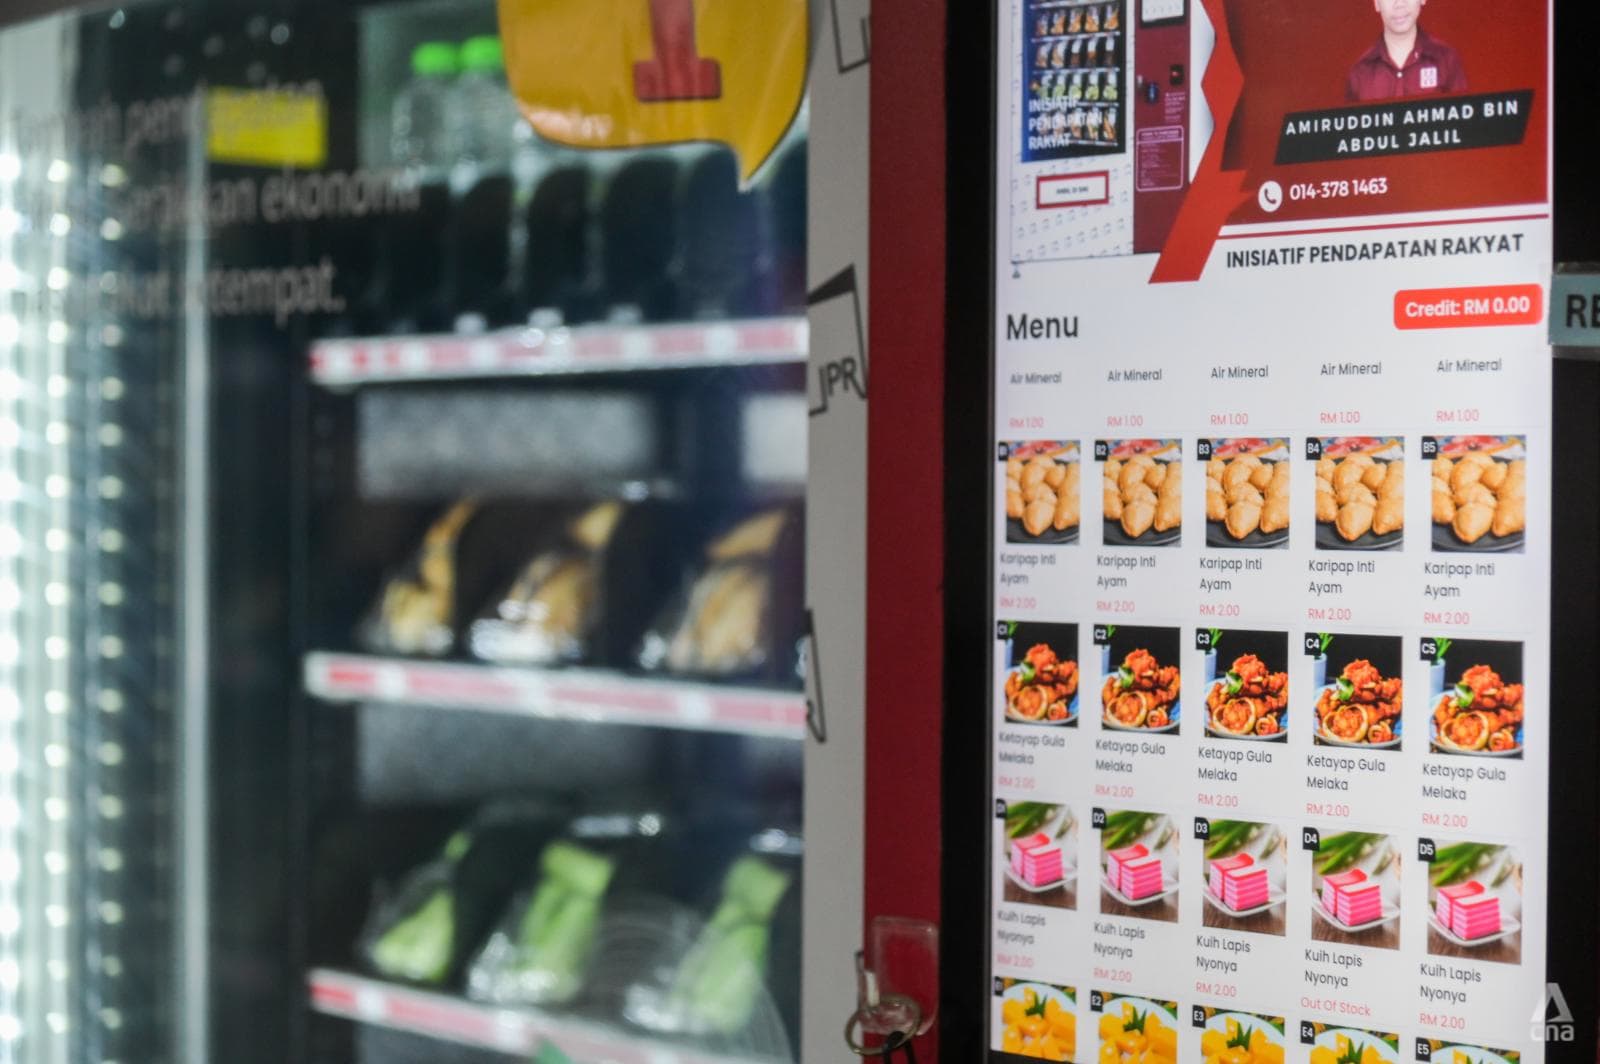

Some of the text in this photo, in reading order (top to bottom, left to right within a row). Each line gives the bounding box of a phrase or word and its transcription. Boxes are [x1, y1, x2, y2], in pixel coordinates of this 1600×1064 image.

[1286, 100, 1517, 135] AMIRUDDIN AHMAD BIN
[1338, 129, 1460, 152] ABDUL JALIL
[1290, 177, 1387, 200] 014-378 1463
[1227, 234, 1523, 268] INISIATIF PENDAPATAN RAKYAT
[1406, 296, 1530, 317] Credit: RM 0.00
[1007, 314, 1078, 340] Menu
[1211, 366, 1268, 378] Air Mineral
[1321, 362, 1381, 375] Air Mineral
[1437, 359, 1501, 372] Air Mineral
[1108, 369, 1162, 381] Air Mineral
[1211, 413, 1248, 425] RM 1.00
[1320, 411, 1360, 423] RM 1.00
[1436, 409, 1479, 422] RM 1.00
[1198, 444, 1210, 454] B3
[1307, 443, 1320, 454] B4
[1423, 442, 1436, 452] B5
[1097, 555, 1155, 570] Karipap Inti
[1200, 557, 1262, 573] Karipap Inti
[1309, 560, 1374, 576] Karipap Inti
[1425, 563, 1494, 577] Karipap Inti
[1097, 576, 1127, 589] Ayam
[1200, 578, 1231, 593] Ayam
[1309, 581, 1342, 596] Ayam
[1424, 585, 1459, 599] Ayam
[1200, 604, 1240, 616] RM 2.00
[1308, 608, 1352, 620] RM 2.00
[1424, 612, 1469, 624] RM 2.00
[1198, 633, 1210, 644] C3
[1306, 638, 1320, 649] C4
[1422, 643, 1436, 655] C5
[1096, 740, 1165, 755] Ketayap Gula
[1199, 747, 1272, 764] Ketayap Gula
[1096, 760, 1132, 772] Melaka
[1308, 755, 1385, 772] Ketayap Gula
[1198, 768, 1237, 781] Melaka
[1423, 764, 1506, 781] Ketayap Gula
[1307, 776, 1348, 790] Melaka
[1198, 793, 1238, 807] RM 2.00
[1423, 786, 1466, 800] Melaka
[1307, 803, 1349, 817] RM 2.00
[1422, 813, 1468, 828] RM 2.00
[1196, 823, 1208, 834] D3
[1304, 833, 1318, 844] D4
[1420, 844, 1434, 856] D5
[1094, 922, 1145, 940] Kuih Lapis
[1094, 942, 1132, 960] Nyonya
[1197, 936, 1250, 954] Kuih Lapis
[1197, 956, 1237, 974] Nyonya
[1305, 949, 1362, 968] Kuih Lapis
[1305, 970, 1348, 989] Nyonya
[1421, 964, 1481, 984] Kuih Lapis
[1196, 982, 1237, 997] RM 2.00
[1420, 985, 1466, 1004] Nyonya
[1301, 997, 1370, 1016] Out Of Stock
[1194, 1010, 1204, 1021] E3
[1420, 1013, 1465, 1030] RM 2.00
[1302, 1026, 1313, 1038] E4
[1418, 1044, 1428, 1055] E5
